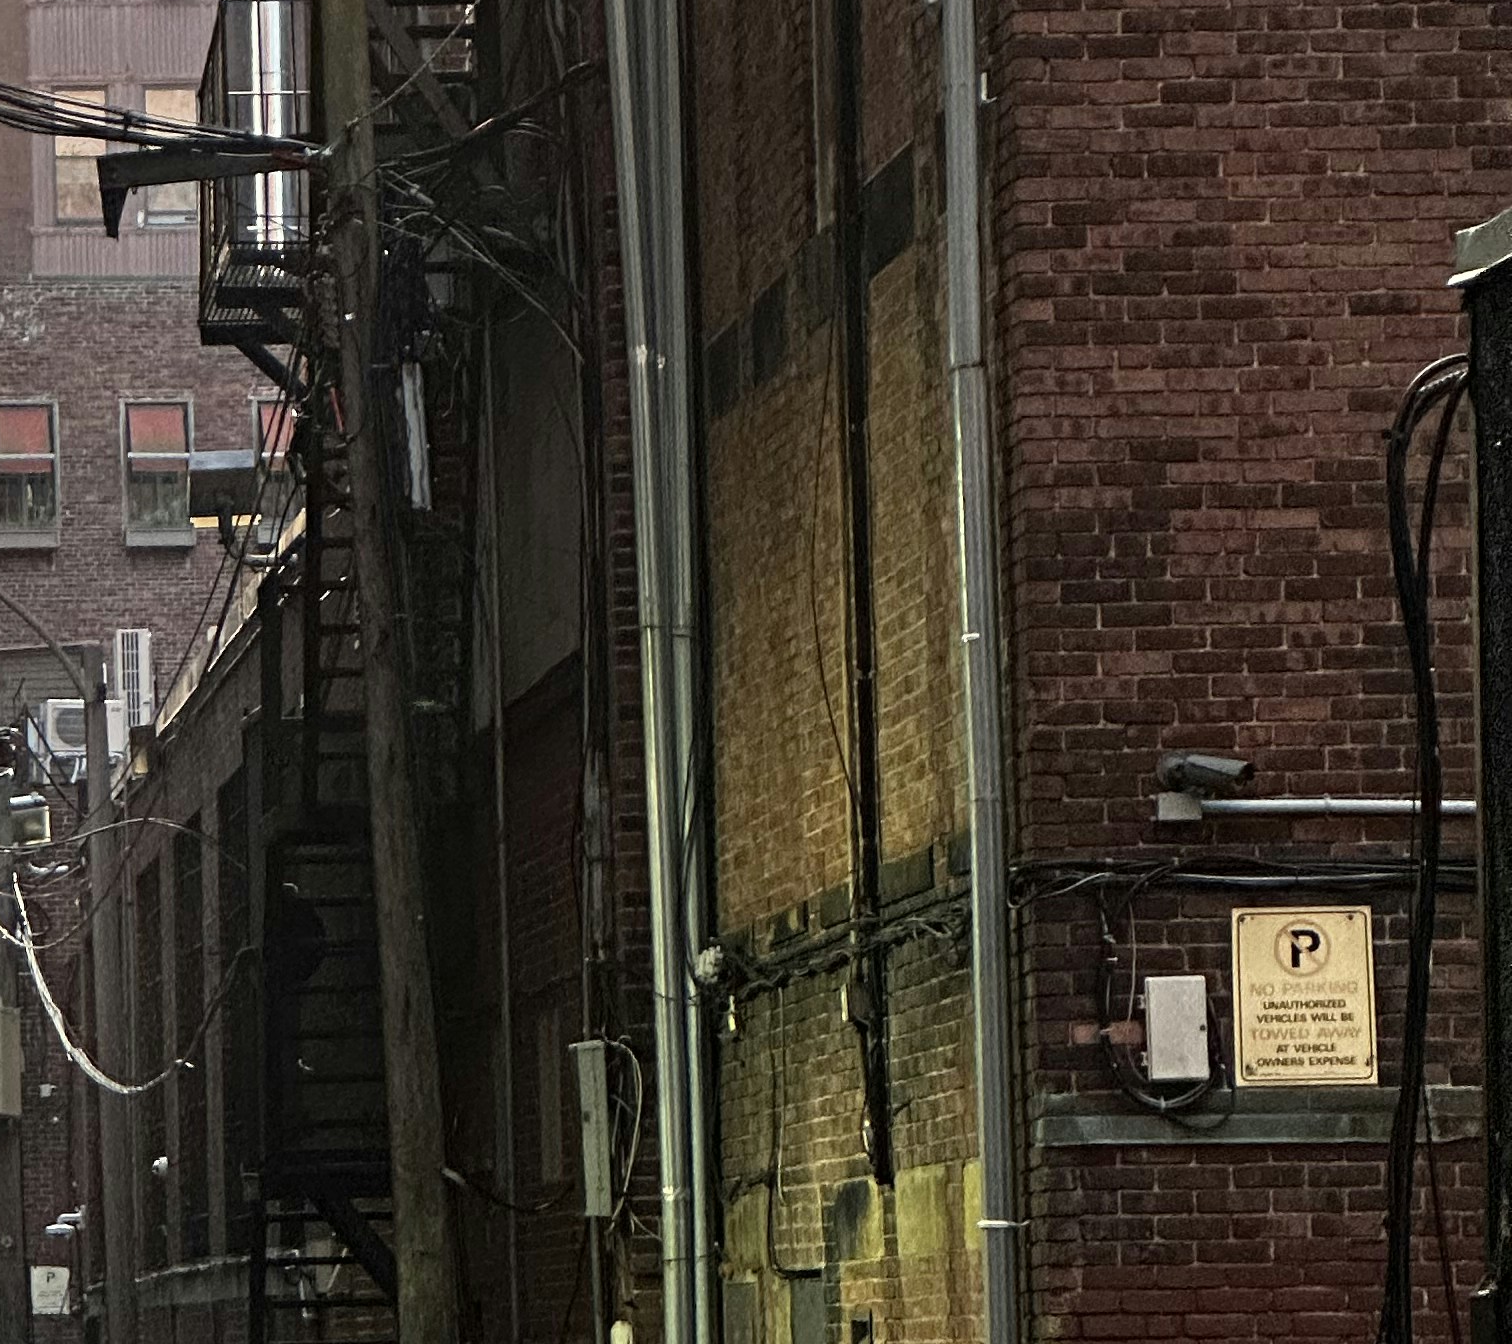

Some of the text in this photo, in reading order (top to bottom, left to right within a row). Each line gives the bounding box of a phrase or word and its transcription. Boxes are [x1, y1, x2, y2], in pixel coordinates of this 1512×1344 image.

[1250, 981, 1358, 996] NO PARKING
[1263, 999, 1346, 1010] UNAUTHORIZED
[1256, 1012, 1354, 1024] VEHICLES WILL BE
[1251, 1025, 1361, 1040] TOWED AWAY
[1276, 1042, 1337, 1054] AT VEHICLE
[1256, 1056, 1357, 1067] OWNERS EXPENSE
